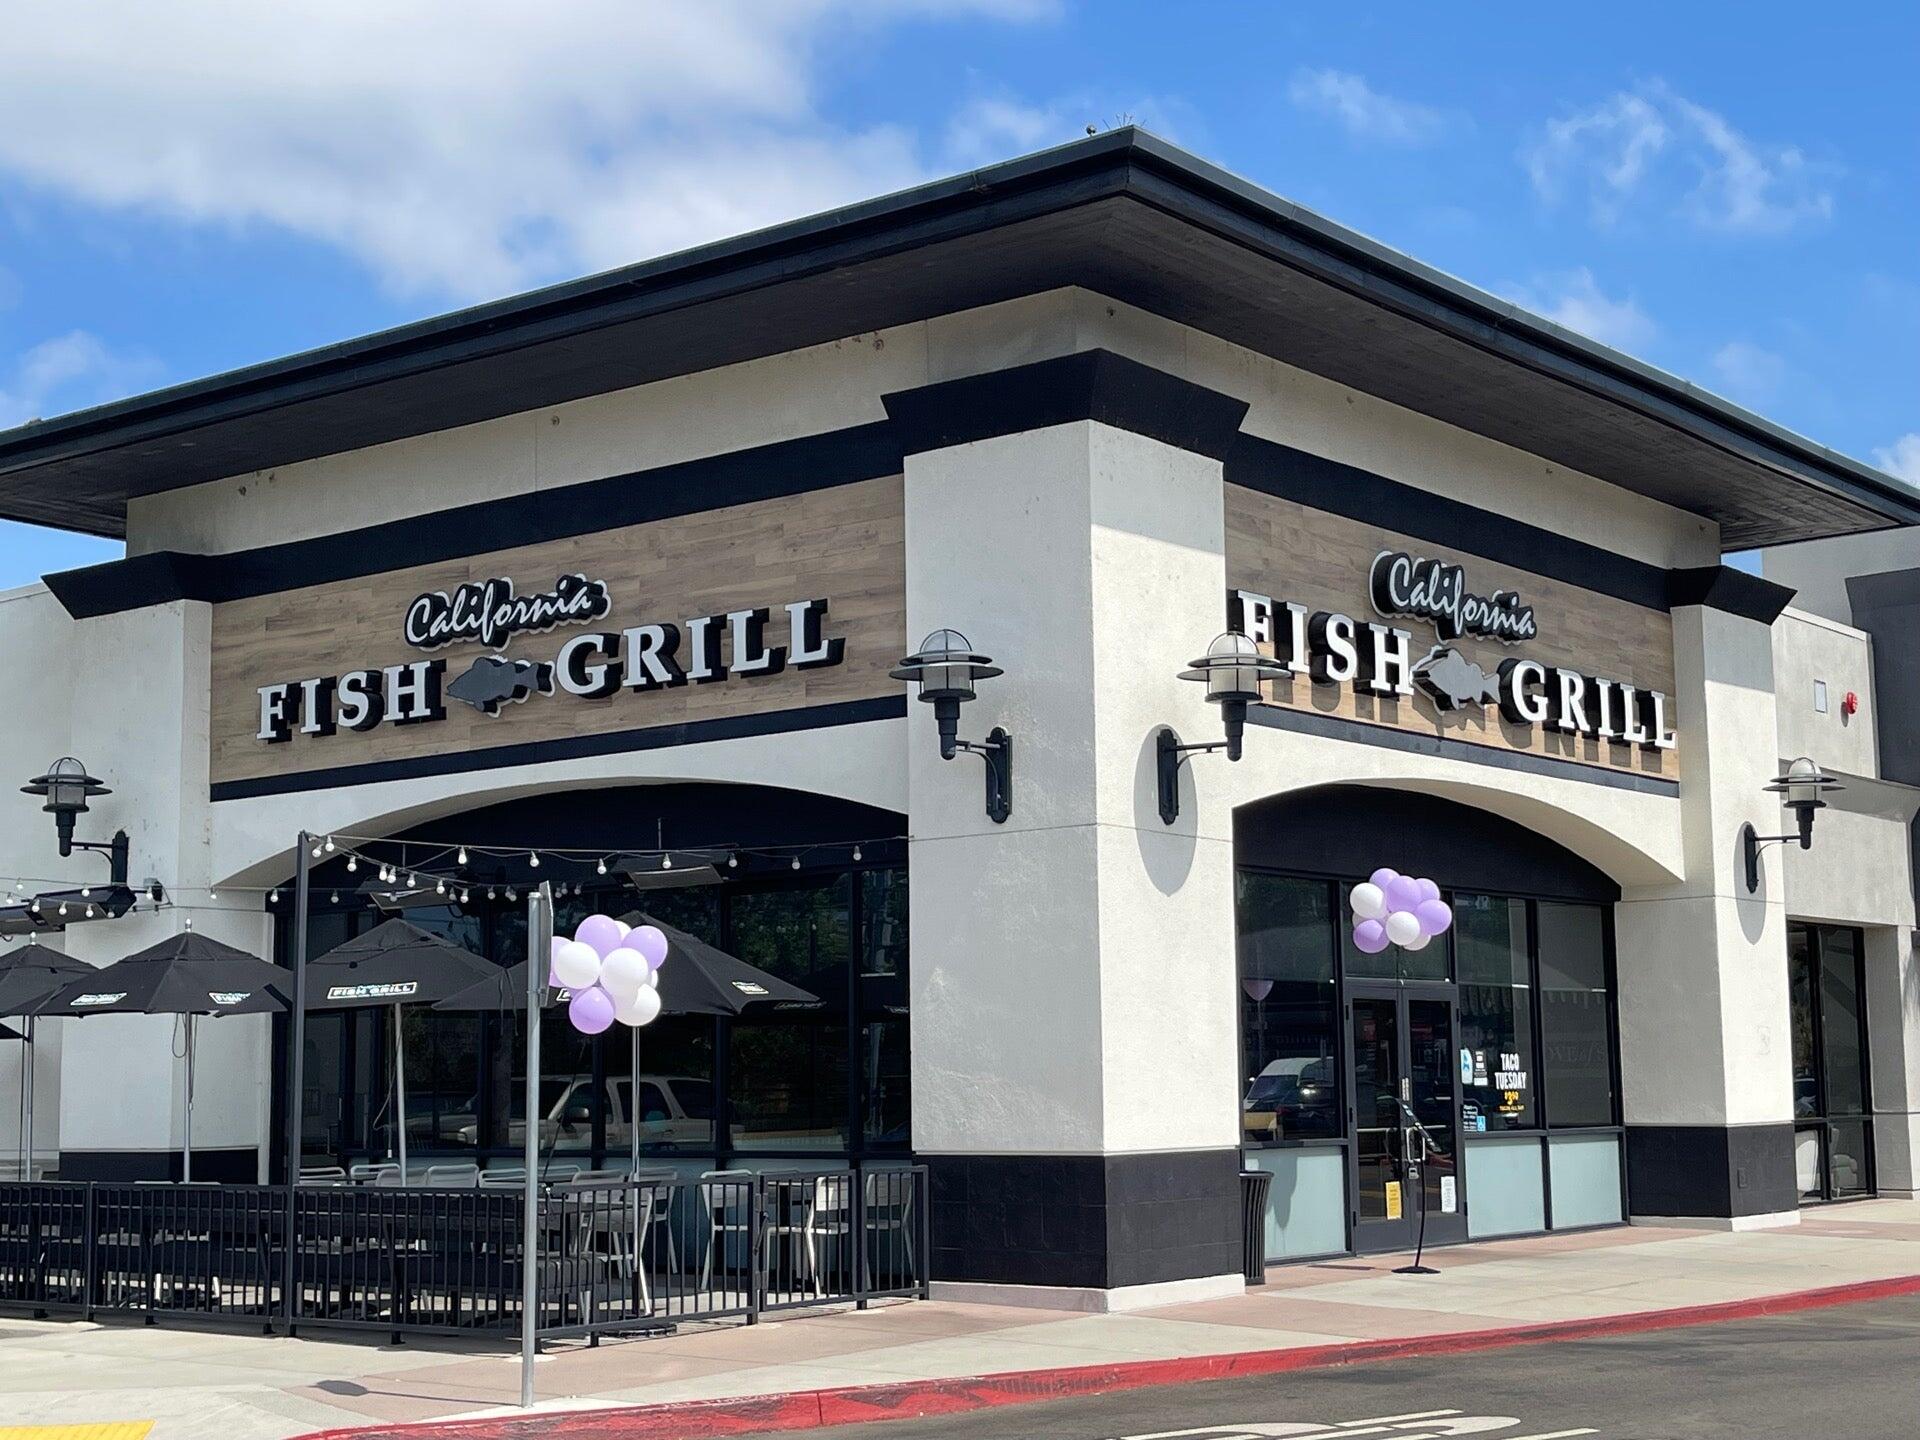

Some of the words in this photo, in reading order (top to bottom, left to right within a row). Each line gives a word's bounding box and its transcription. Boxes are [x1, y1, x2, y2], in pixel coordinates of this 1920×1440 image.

[405, 577, 594, 645] California
[1388, 556, 1537, 638] California
[256, 660, 436, 741] FISH
[556, 599, 832, 697] GRILL
[1236, 589, 1415, 696] FISH
[1511, 658, 1677, 750] GRILL
[1494, 1071, 1527, 1090] TUESDAY
[1500, 1053, 1520, 1070] TACO
